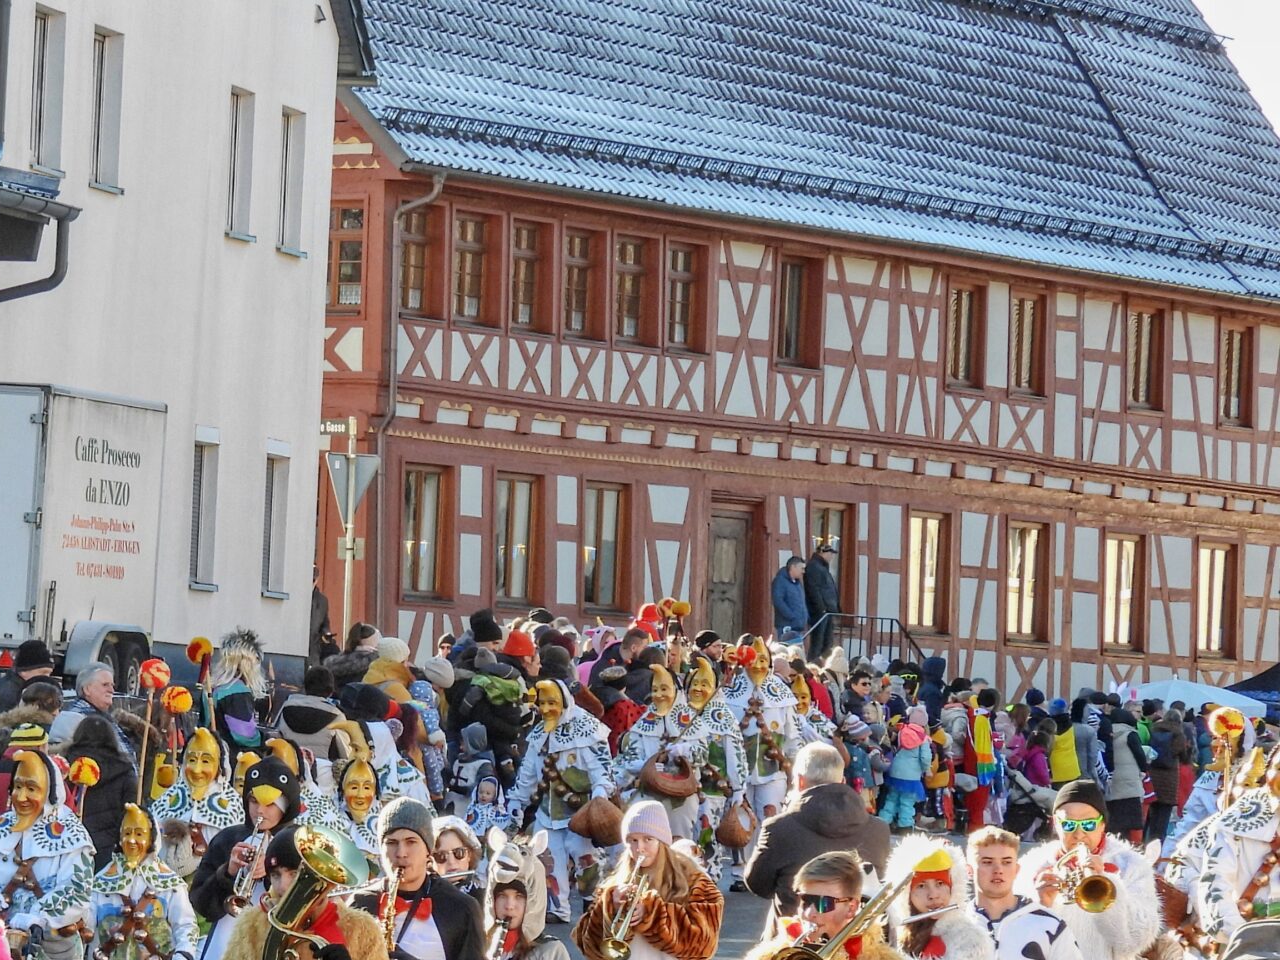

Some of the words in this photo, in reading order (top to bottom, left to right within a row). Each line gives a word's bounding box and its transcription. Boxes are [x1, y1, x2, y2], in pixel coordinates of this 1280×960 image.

[326, 421, 346, 433] Gasse
[101, 439, 141, 469] Prosecco
[85, 477, 97, 503] da
[99, 479, 130, 507] ENZO
